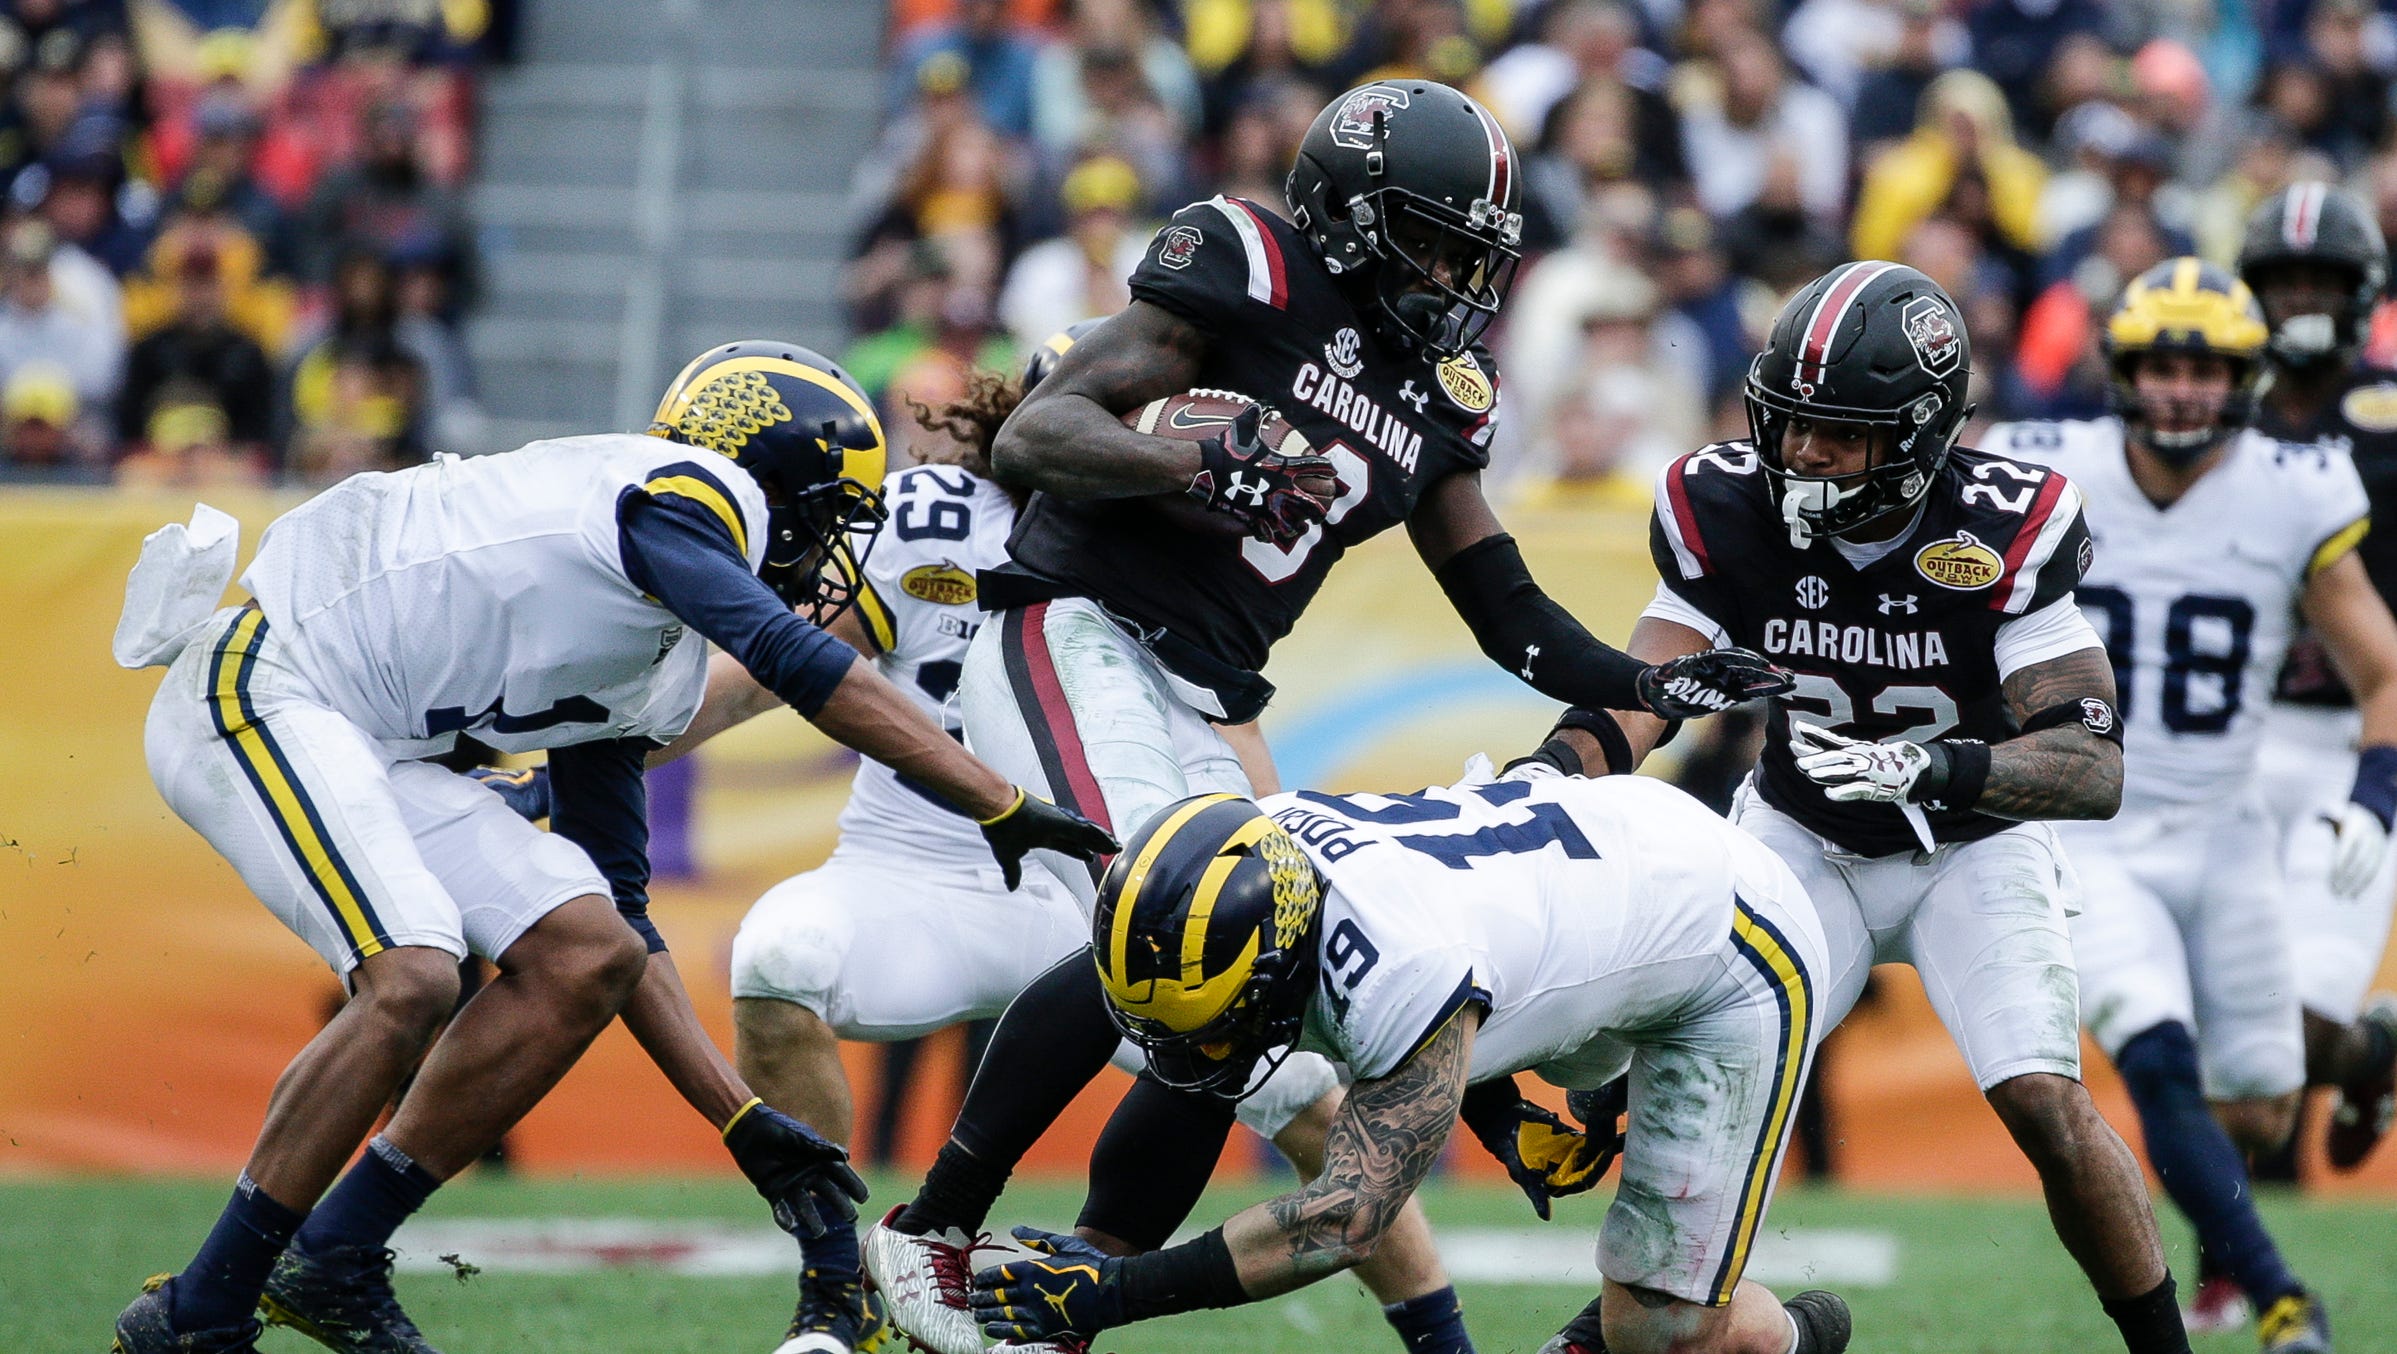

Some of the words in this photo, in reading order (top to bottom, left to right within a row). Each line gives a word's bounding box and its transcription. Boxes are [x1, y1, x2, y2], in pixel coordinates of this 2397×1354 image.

[1333, 327, 1361, 365] SEC
[1442, 366, 1486, 405] OUTBACK
[1292, 362, 1423, 475] CAROLINA
[896, 468, 977, 542] 29
[1961, 461, 2045, 514] 22
[1926, 560, 1991, 578] OUTBACK
[1934, 571, 1983, 583] BOWL
[1795, 575, 1829, 610] SEC
[1763, 618, 1950, 670] CAROLINA
[1777, 672, 1961, 748] 22
